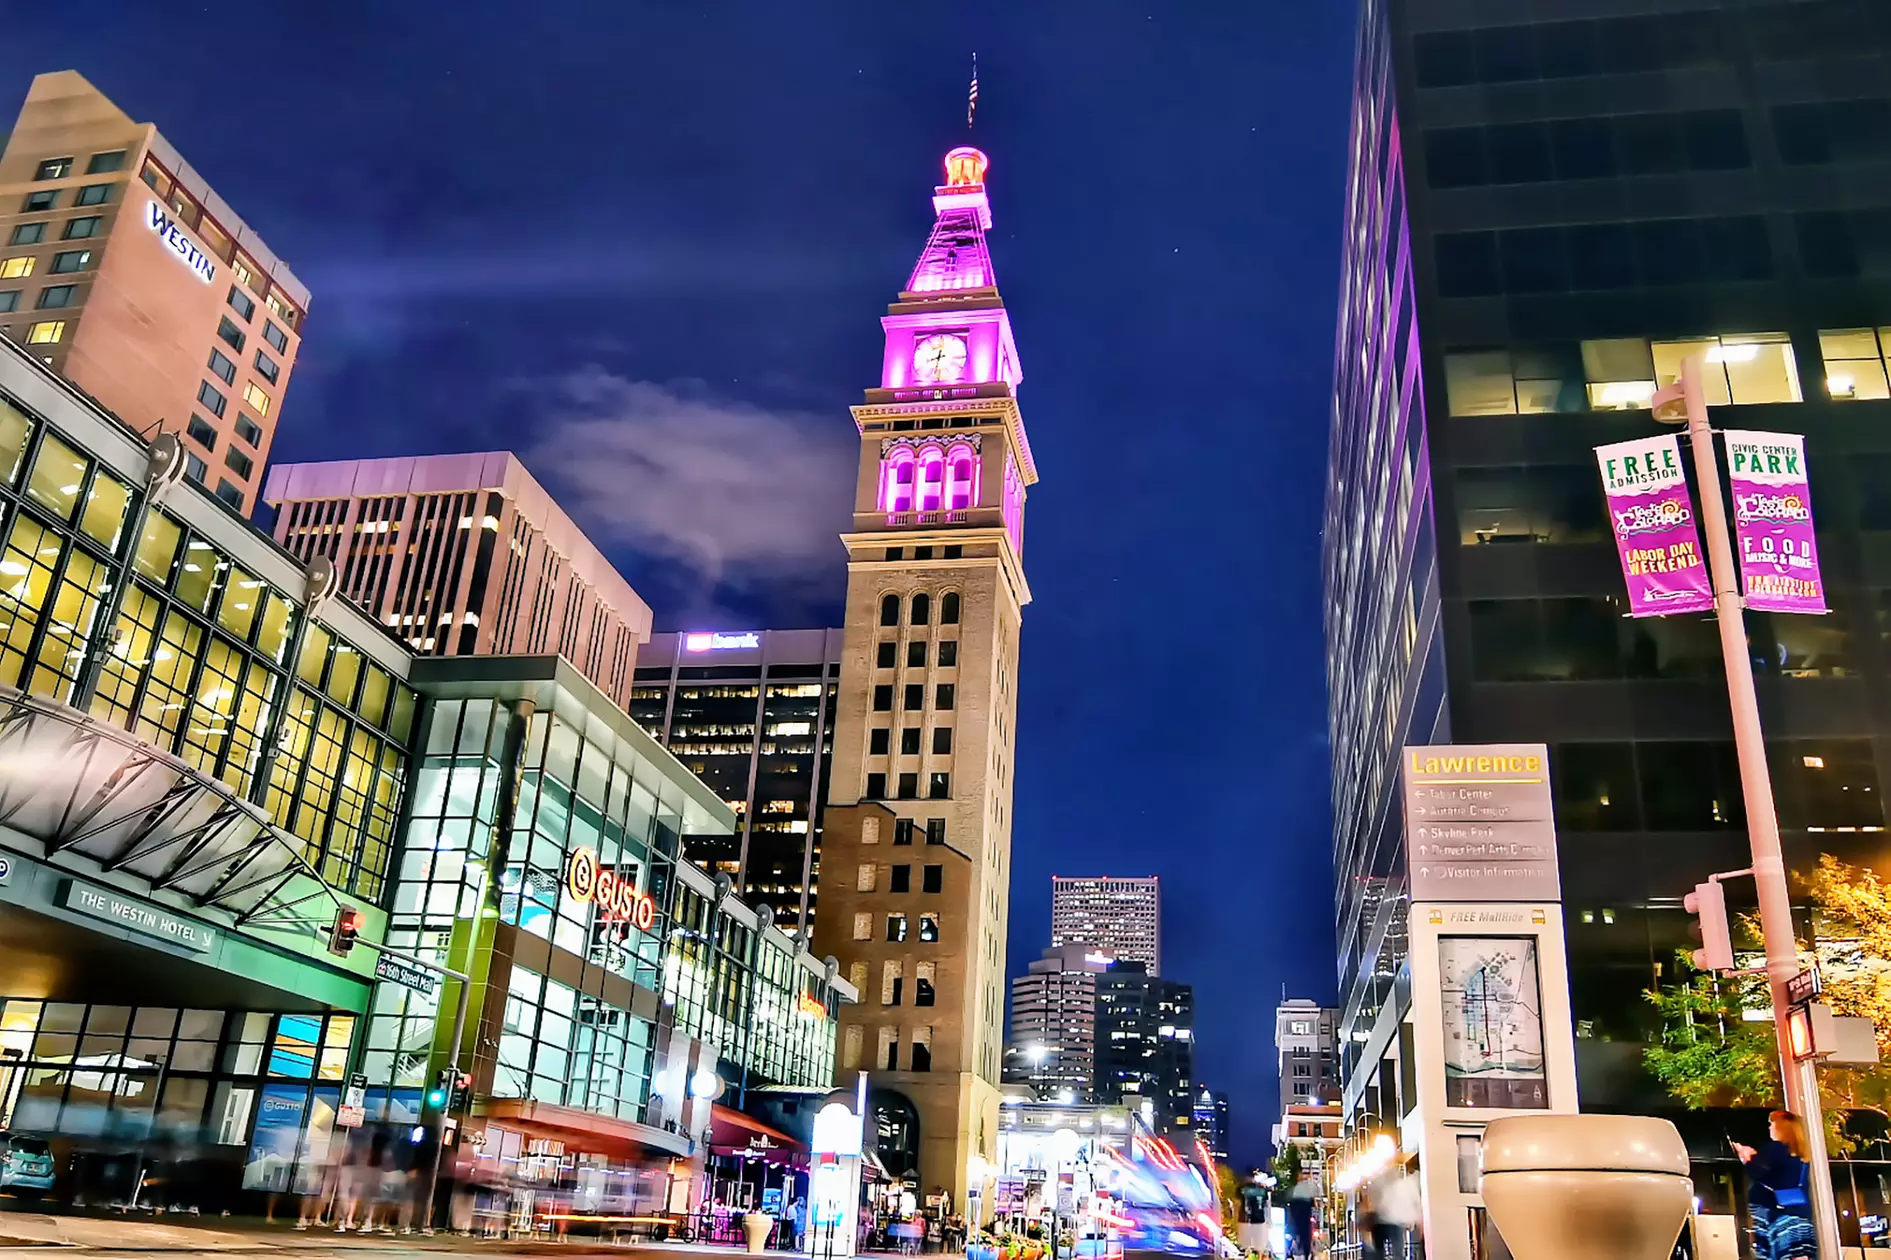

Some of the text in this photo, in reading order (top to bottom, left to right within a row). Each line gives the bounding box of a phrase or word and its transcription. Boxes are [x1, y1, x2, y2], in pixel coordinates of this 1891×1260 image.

[151, 201, 216, 282] WESTIN
[1731, 443, 1798, 457] CIVIC CENTER
[1606, 449, 1677, 480] FREE
[1733, 453, 1801, 475] PARK
[1609, 469, 1678, 489] ADMISSION
[1625, 542, 1694, 564] LABOR DAY
[1743, 536, 1810, 558] FOOD
[1628, 554, 1699, 576] WEEKEND
[1745, 552, 1778, 563] MUSIC
[1779, 553, 1788, 565] &
[1411, 752, 1541, 774] Lawrence
[1430, 788, 1493, 800] Tabr Center
[597, 871, 653, 930] GUSTO
[80, 890, 196, 941] THE WESTIN HOTEL
[1450, 911, 1477, 922] FREE
[400, 968, 420, 988] Street
[419, 974, 434, 992] Mall
